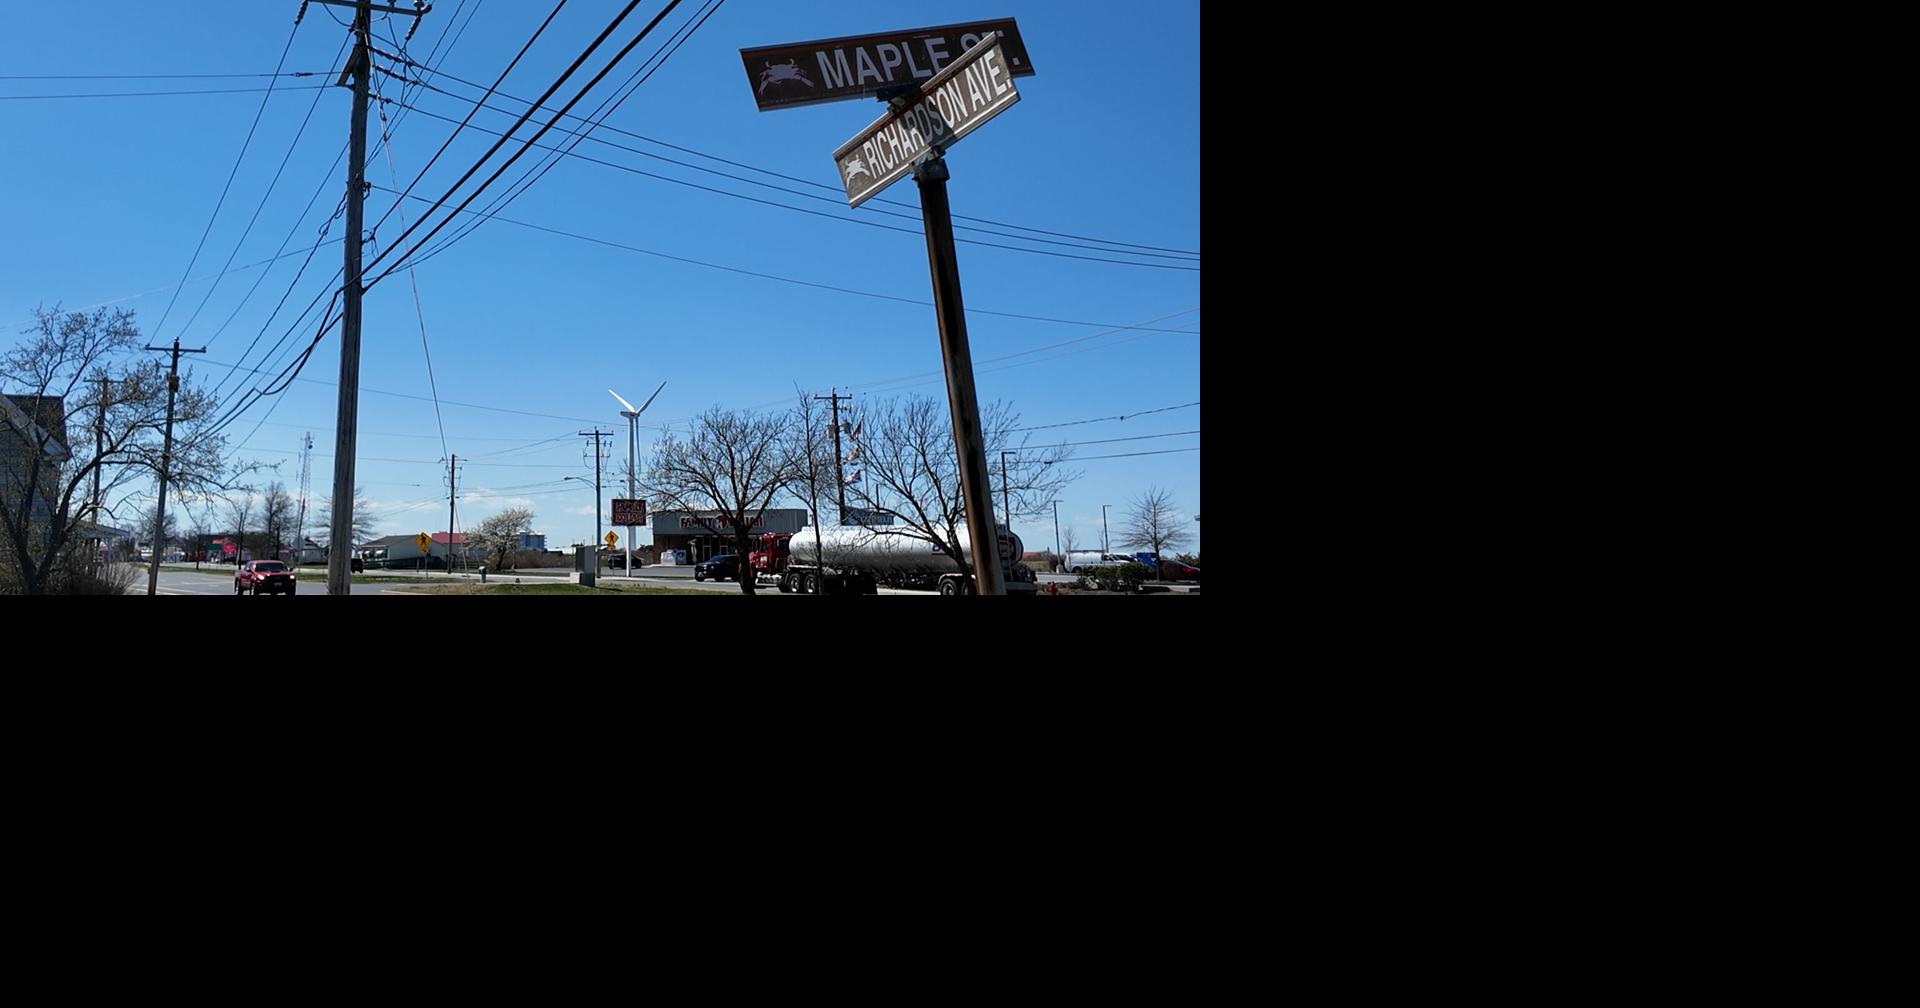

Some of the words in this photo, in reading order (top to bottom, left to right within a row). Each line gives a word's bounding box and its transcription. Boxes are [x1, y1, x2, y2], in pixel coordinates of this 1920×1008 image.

[815, 37, 949, 89] MAPLE
[863, 81, 968, 179] RICHARDSON
[965, 50, 1012, 112] AVE.
